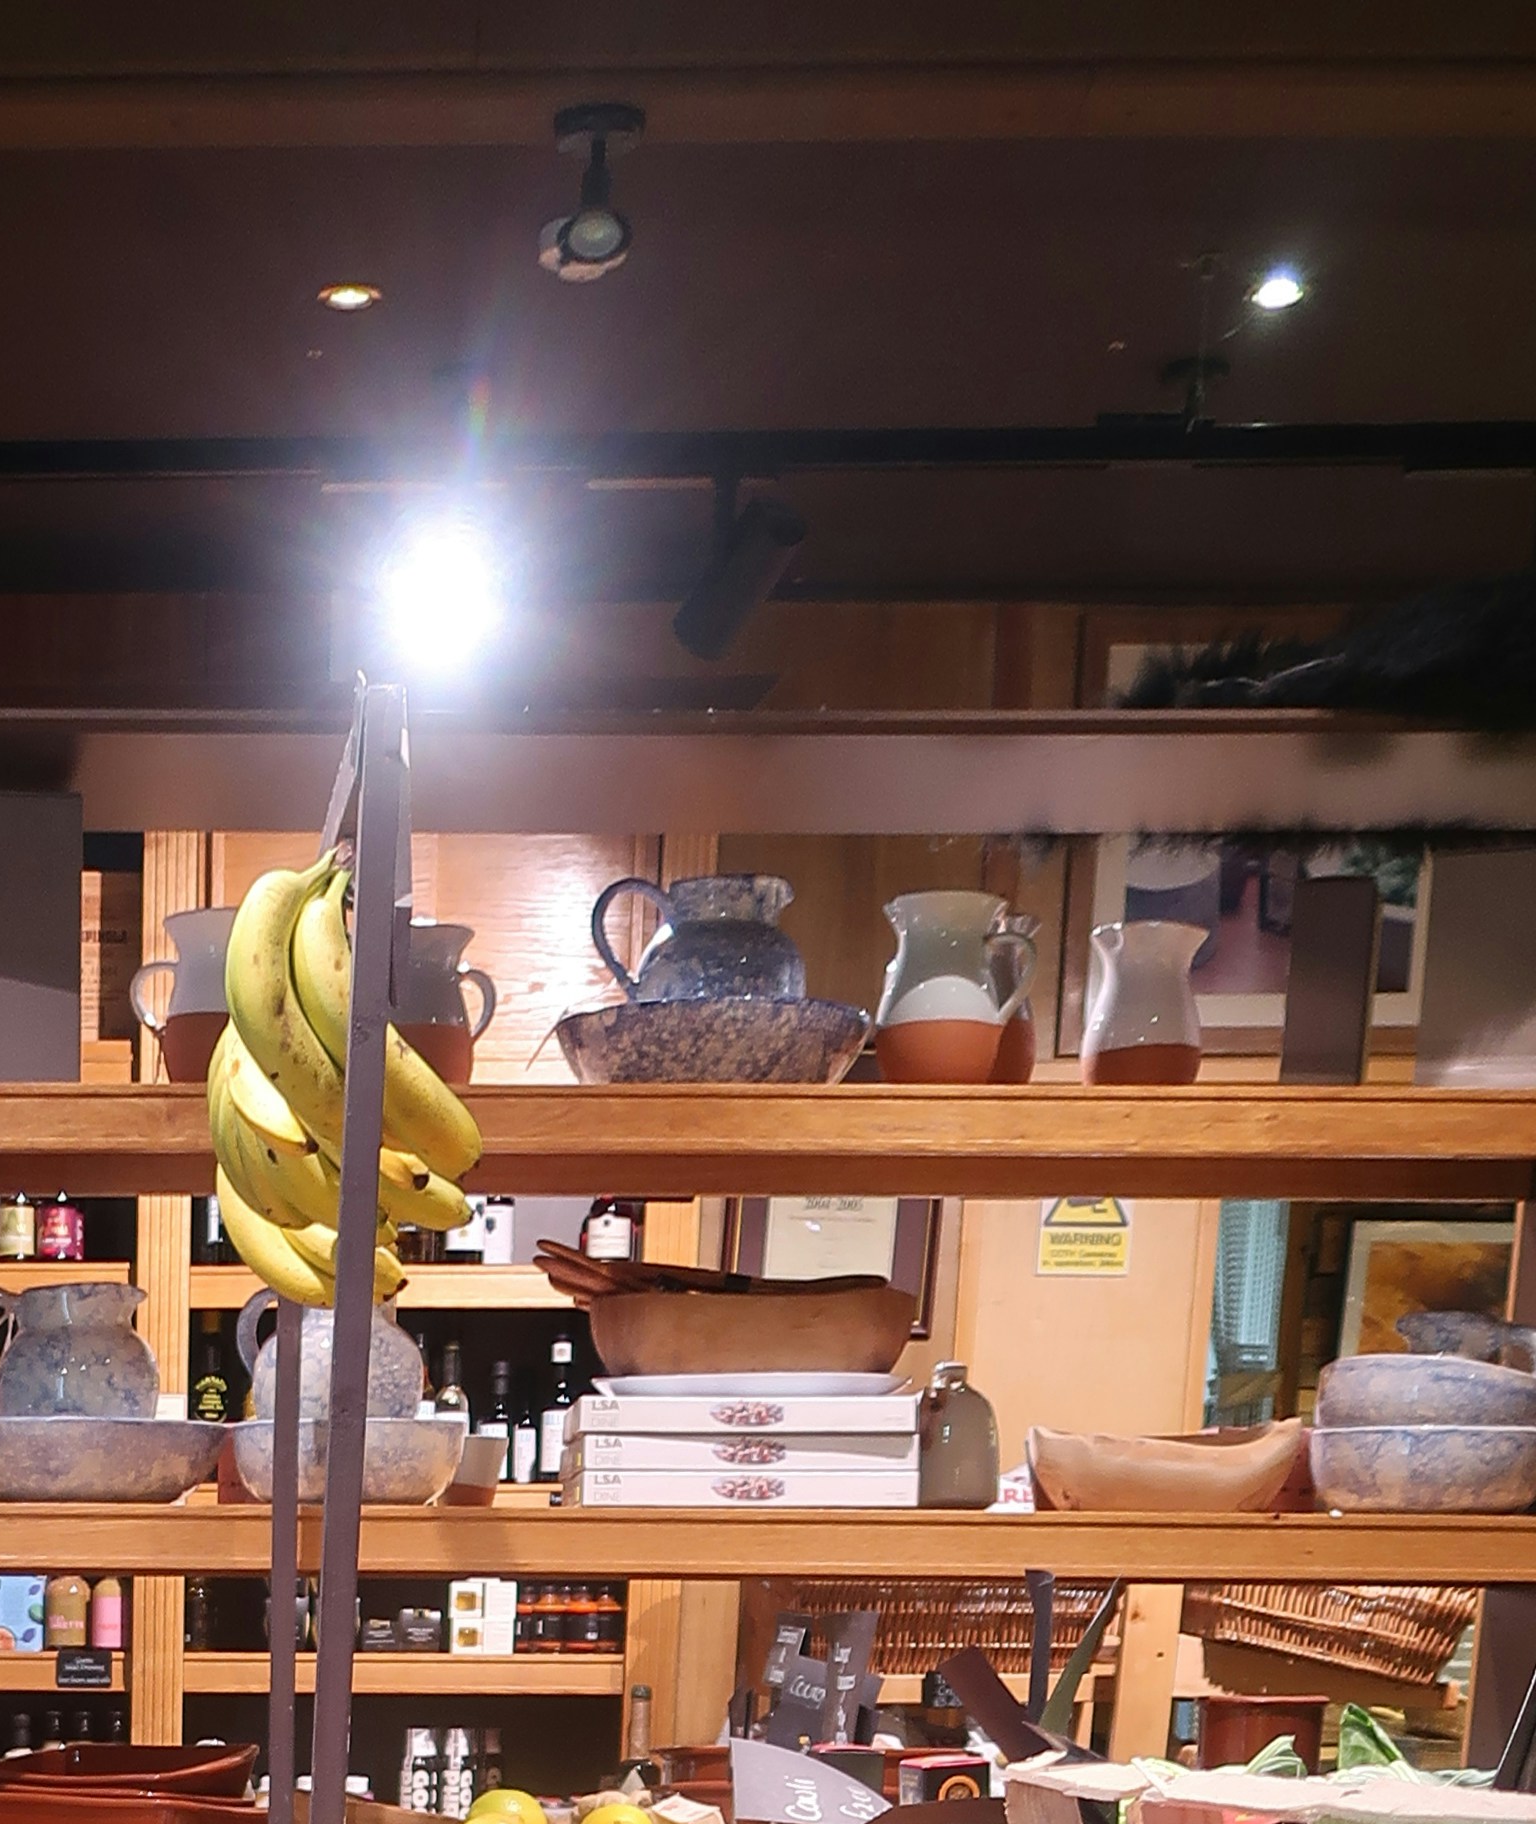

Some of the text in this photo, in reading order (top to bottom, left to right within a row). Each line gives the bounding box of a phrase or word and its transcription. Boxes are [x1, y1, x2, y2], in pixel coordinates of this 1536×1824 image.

[1050, 1232, 1122, 1246] WARNING
[591, 1400, 619, 1411] LSA
[591, 1415, 618, 1427] DINE
[594, 1438, 622, 1449] LSA
[593, 1453, 622, 1466] DINE
[593, 1474, 622, 1485] LSA
[593, 1490, 622, 1502] DINE
